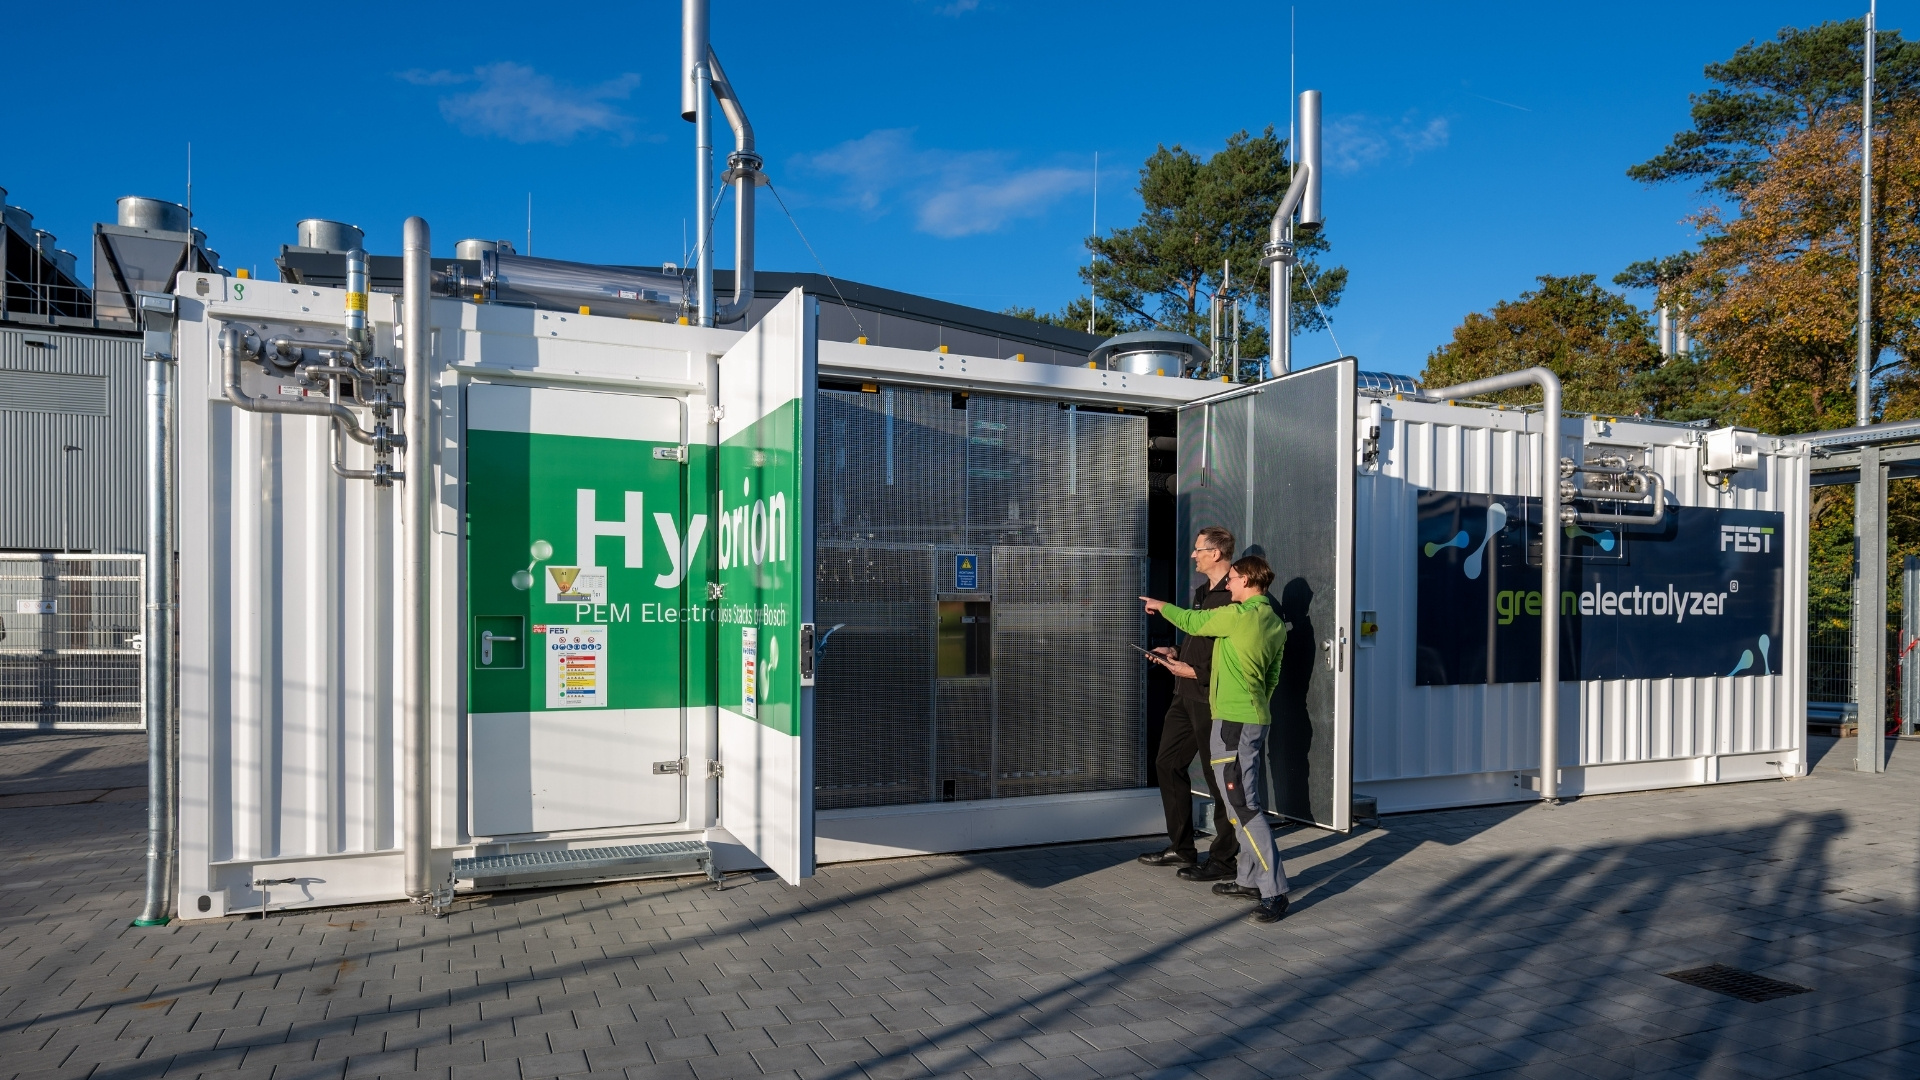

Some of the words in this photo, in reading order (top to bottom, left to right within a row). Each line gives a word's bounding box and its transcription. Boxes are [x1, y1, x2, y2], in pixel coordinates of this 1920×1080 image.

[576, 476, 786, 588] Hybrion
[1720, 525, 1774, 553] FEST
[576, 603, 630, 622] PEM
[733, 603, 753, 625] Stacks
[753, 603, 762, 629] by
[763, 602, 786, 626] Bosch
[1496, 580, 1739, 625] grenelectrolyzer®
